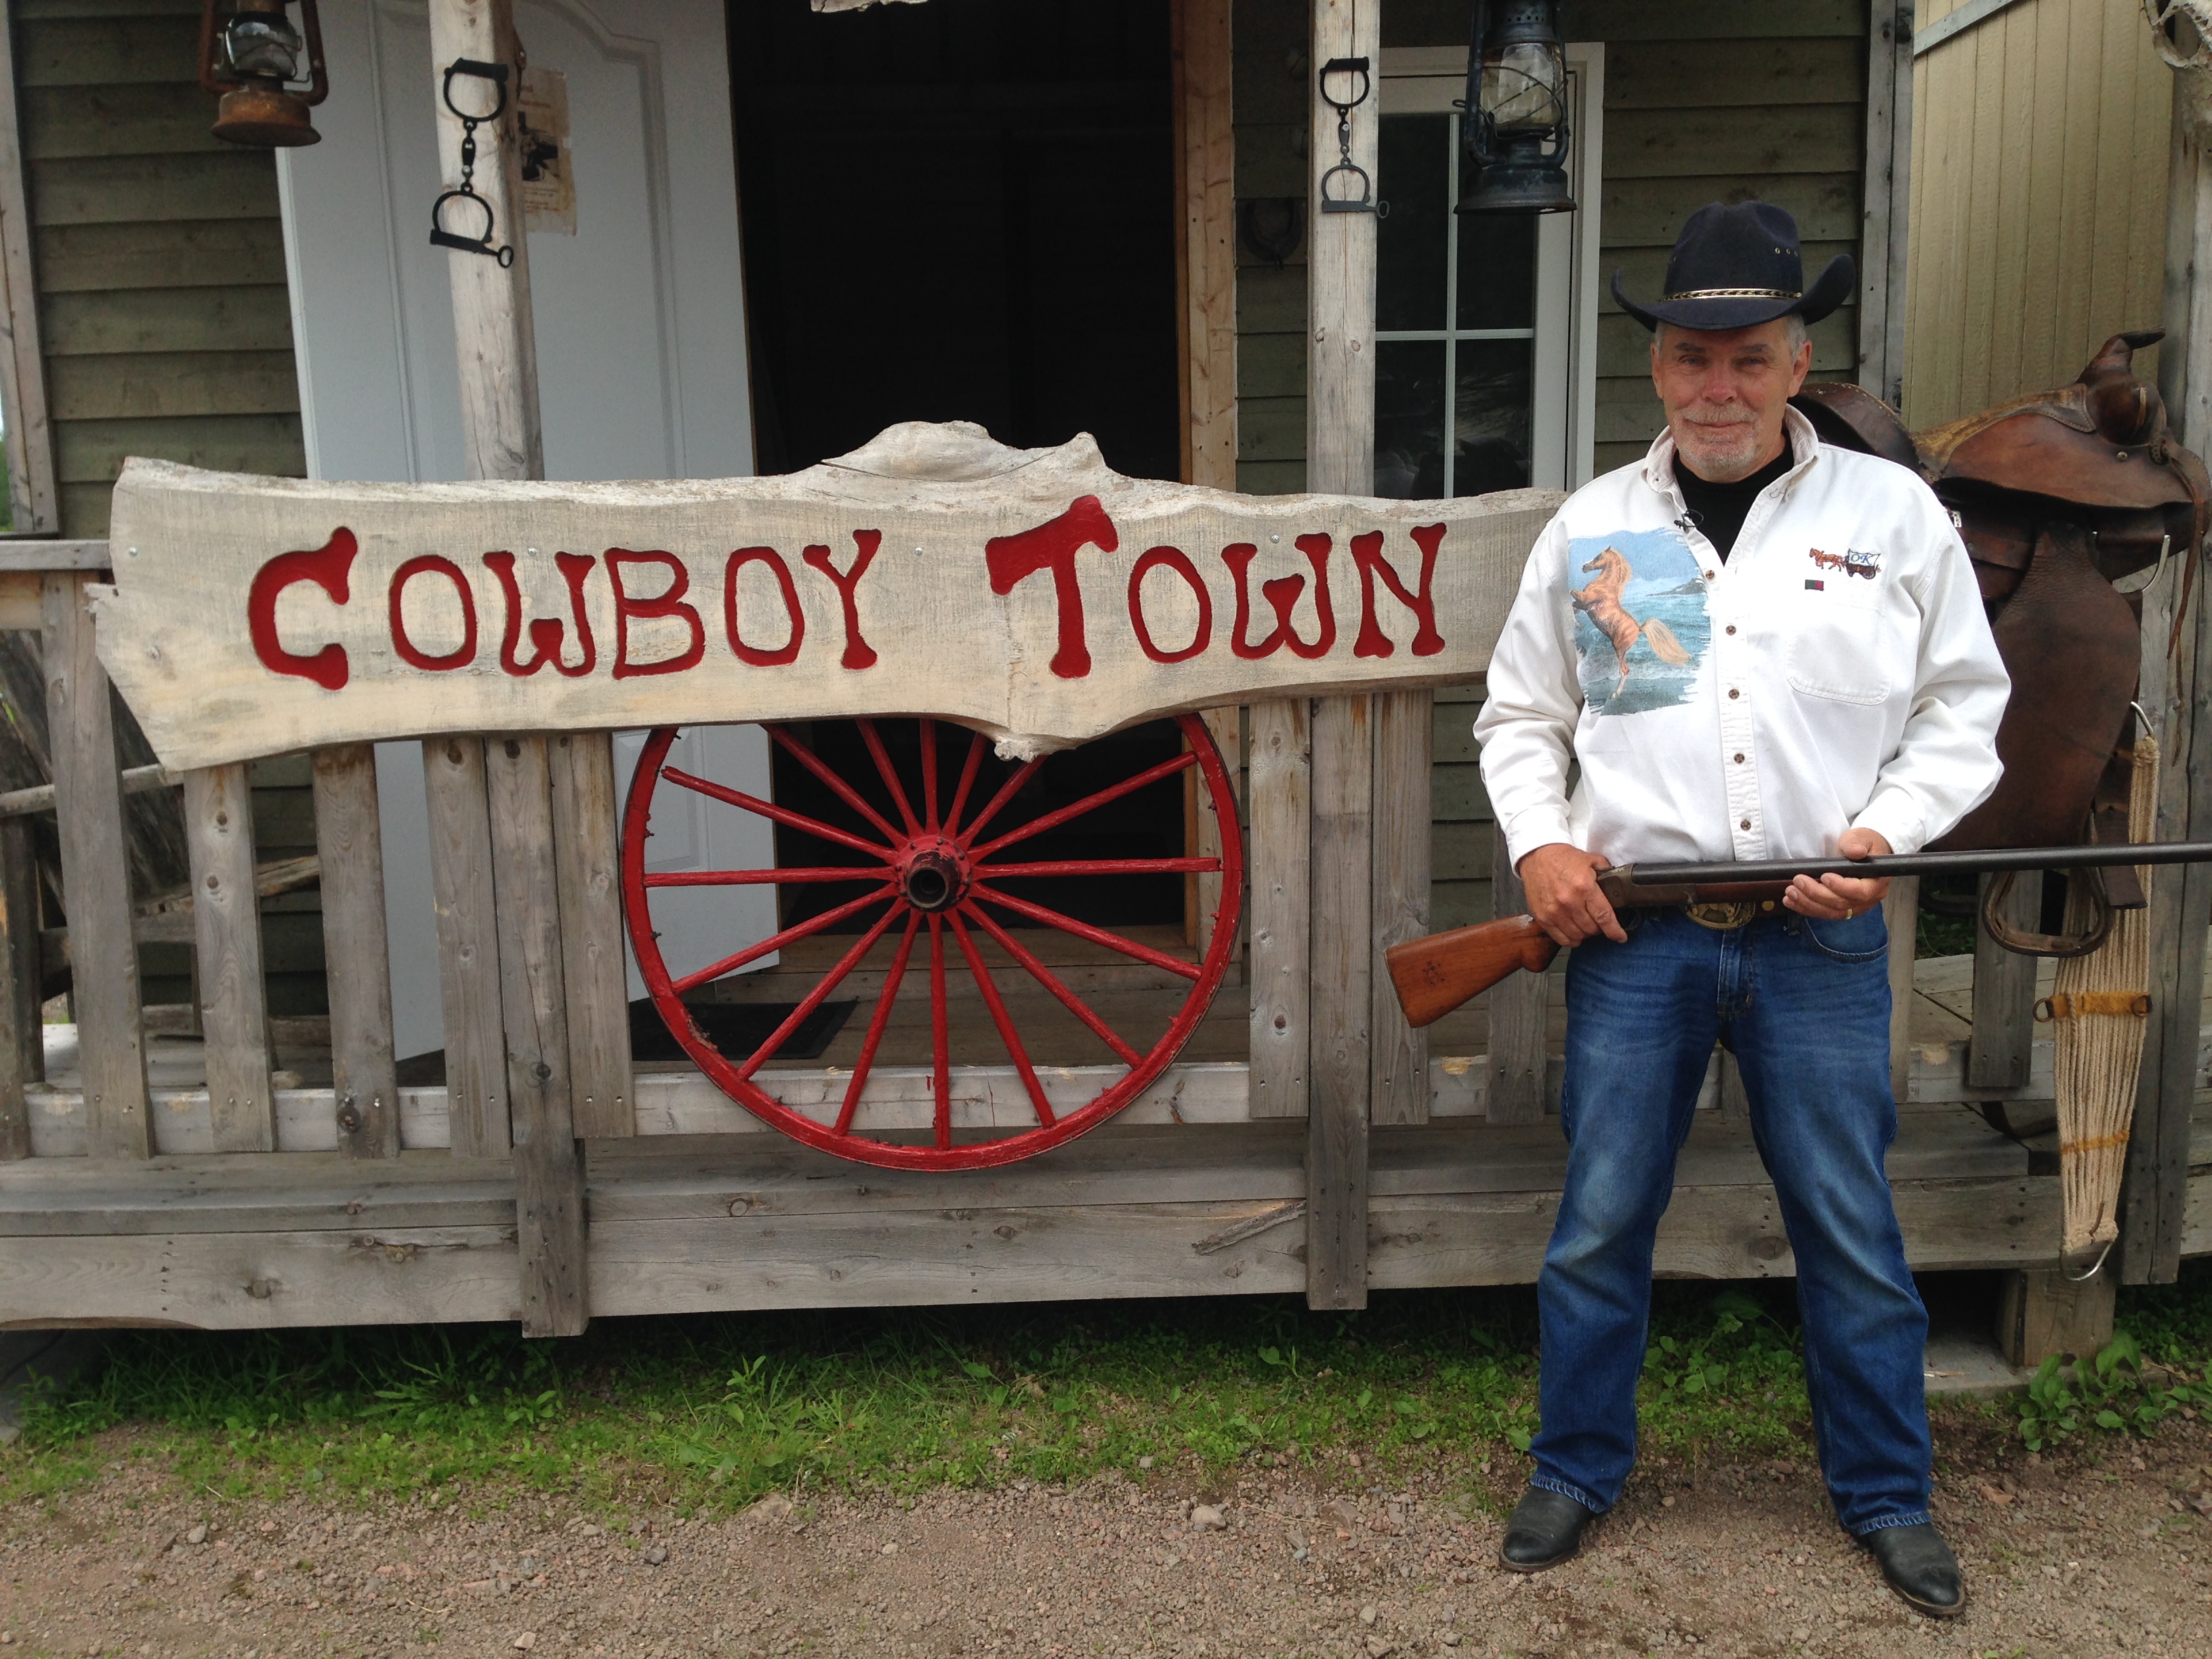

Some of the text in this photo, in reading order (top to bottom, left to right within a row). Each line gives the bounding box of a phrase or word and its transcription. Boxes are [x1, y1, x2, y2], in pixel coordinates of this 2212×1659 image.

[248, 495, 1447, 690] COWBOY TOWN
[1851, 554, 1874, 565] OK
